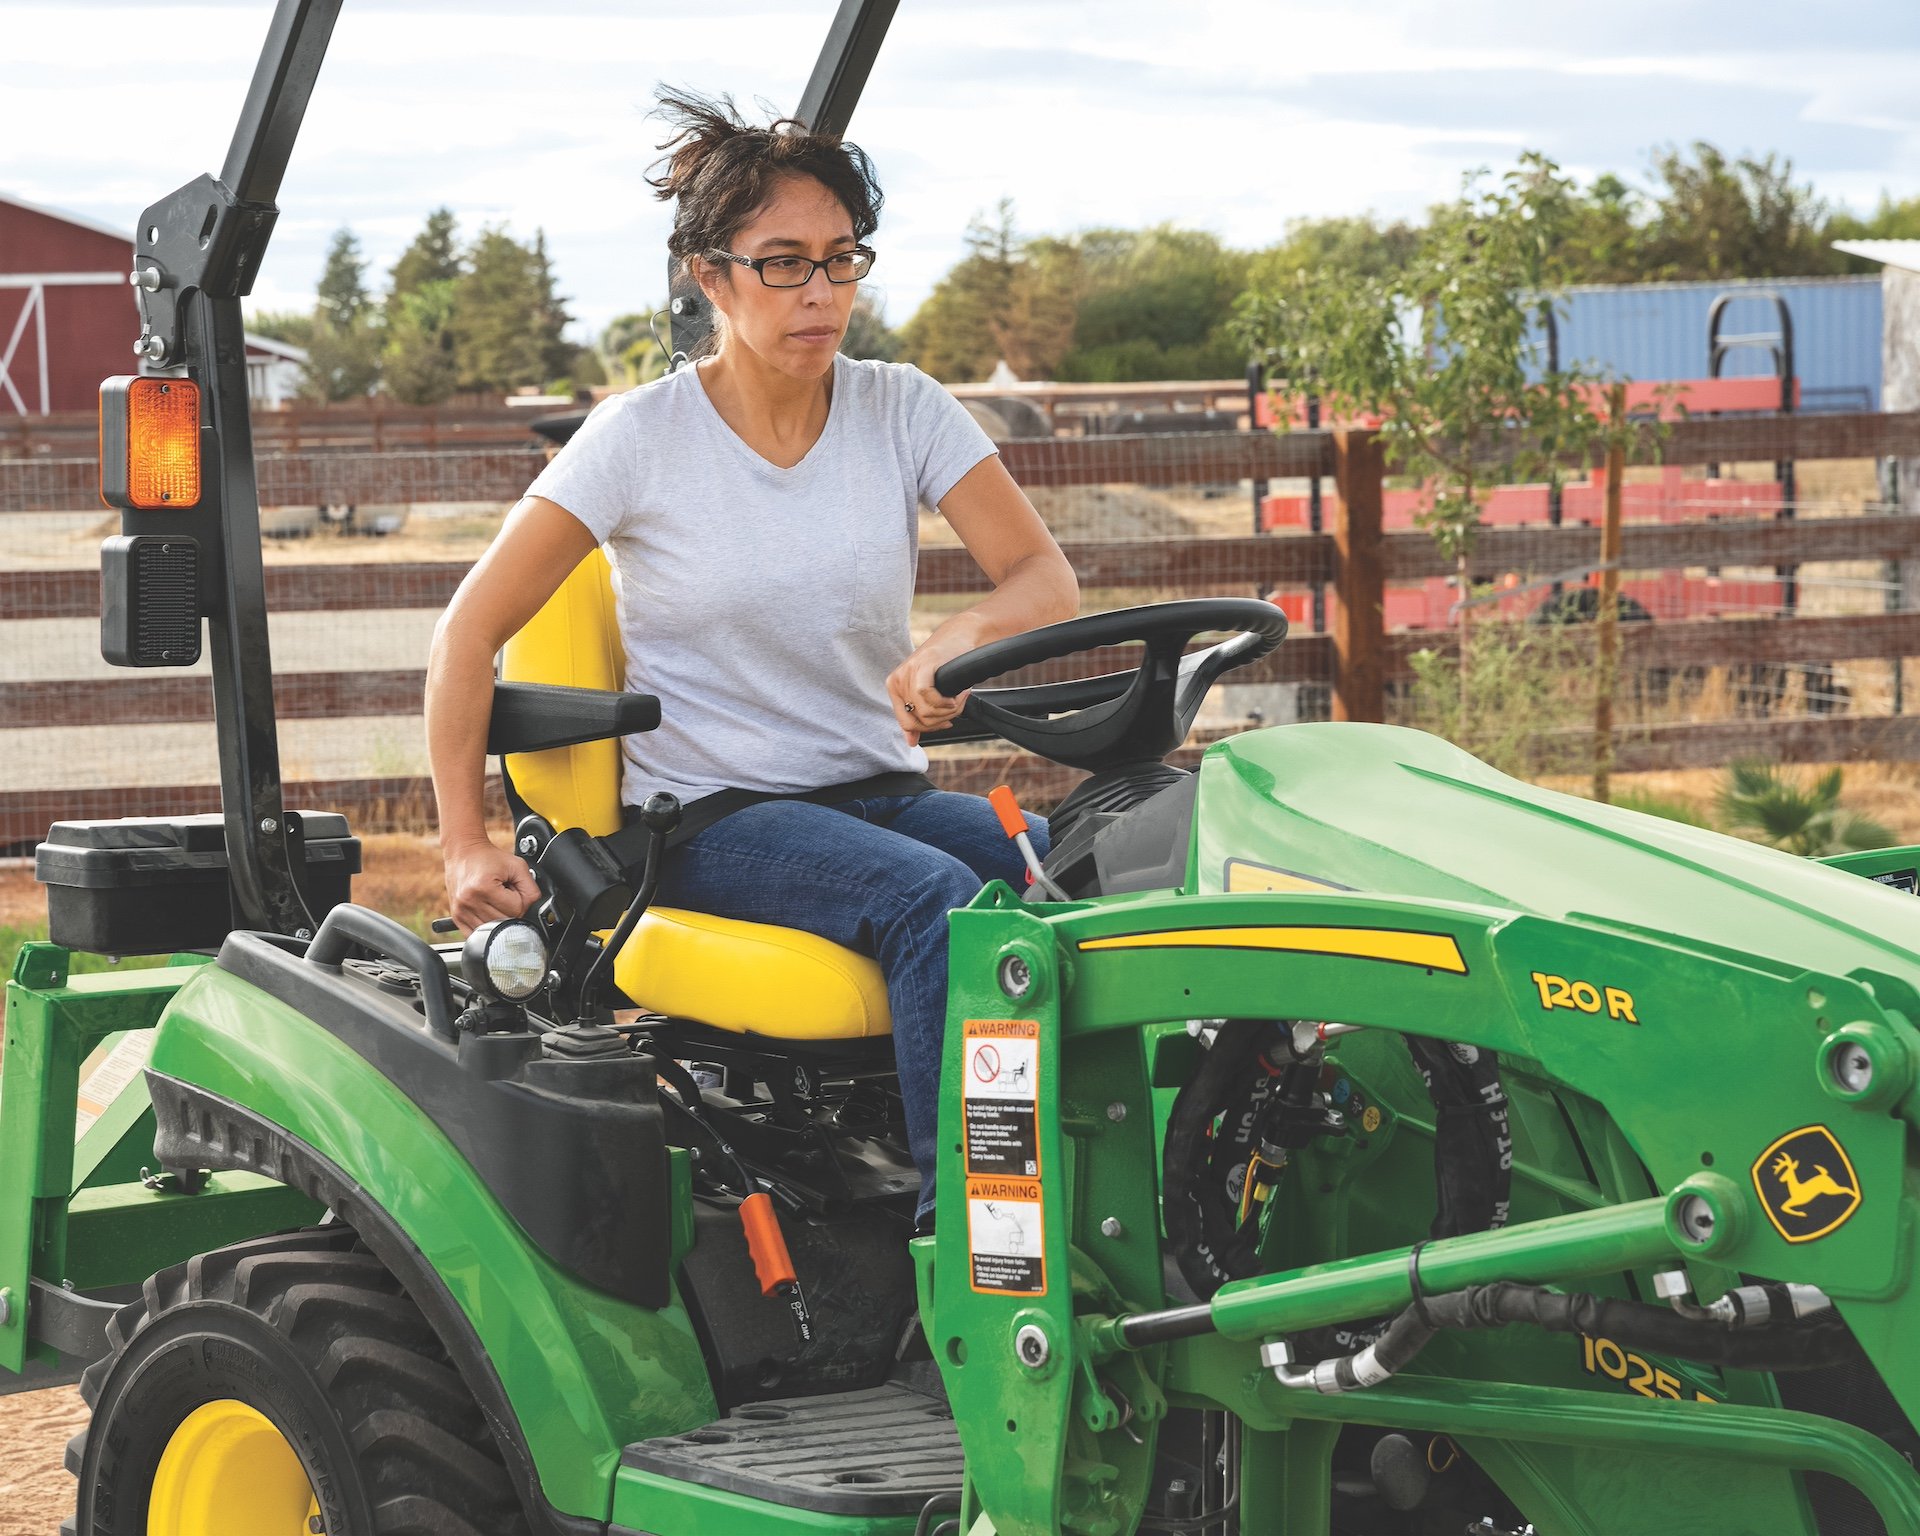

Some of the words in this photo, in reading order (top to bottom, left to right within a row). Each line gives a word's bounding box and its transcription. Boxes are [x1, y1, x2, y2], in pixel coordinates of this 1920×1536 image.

[1531, 971, 1602, 1014] 120
[1604, 986, 1640, 1025] R
[979, 1023, 1036, 1037] WARNING
[981, 1183, 1038, 1199] WARNING
[1583, 1332, 1682, 1400] 1025
